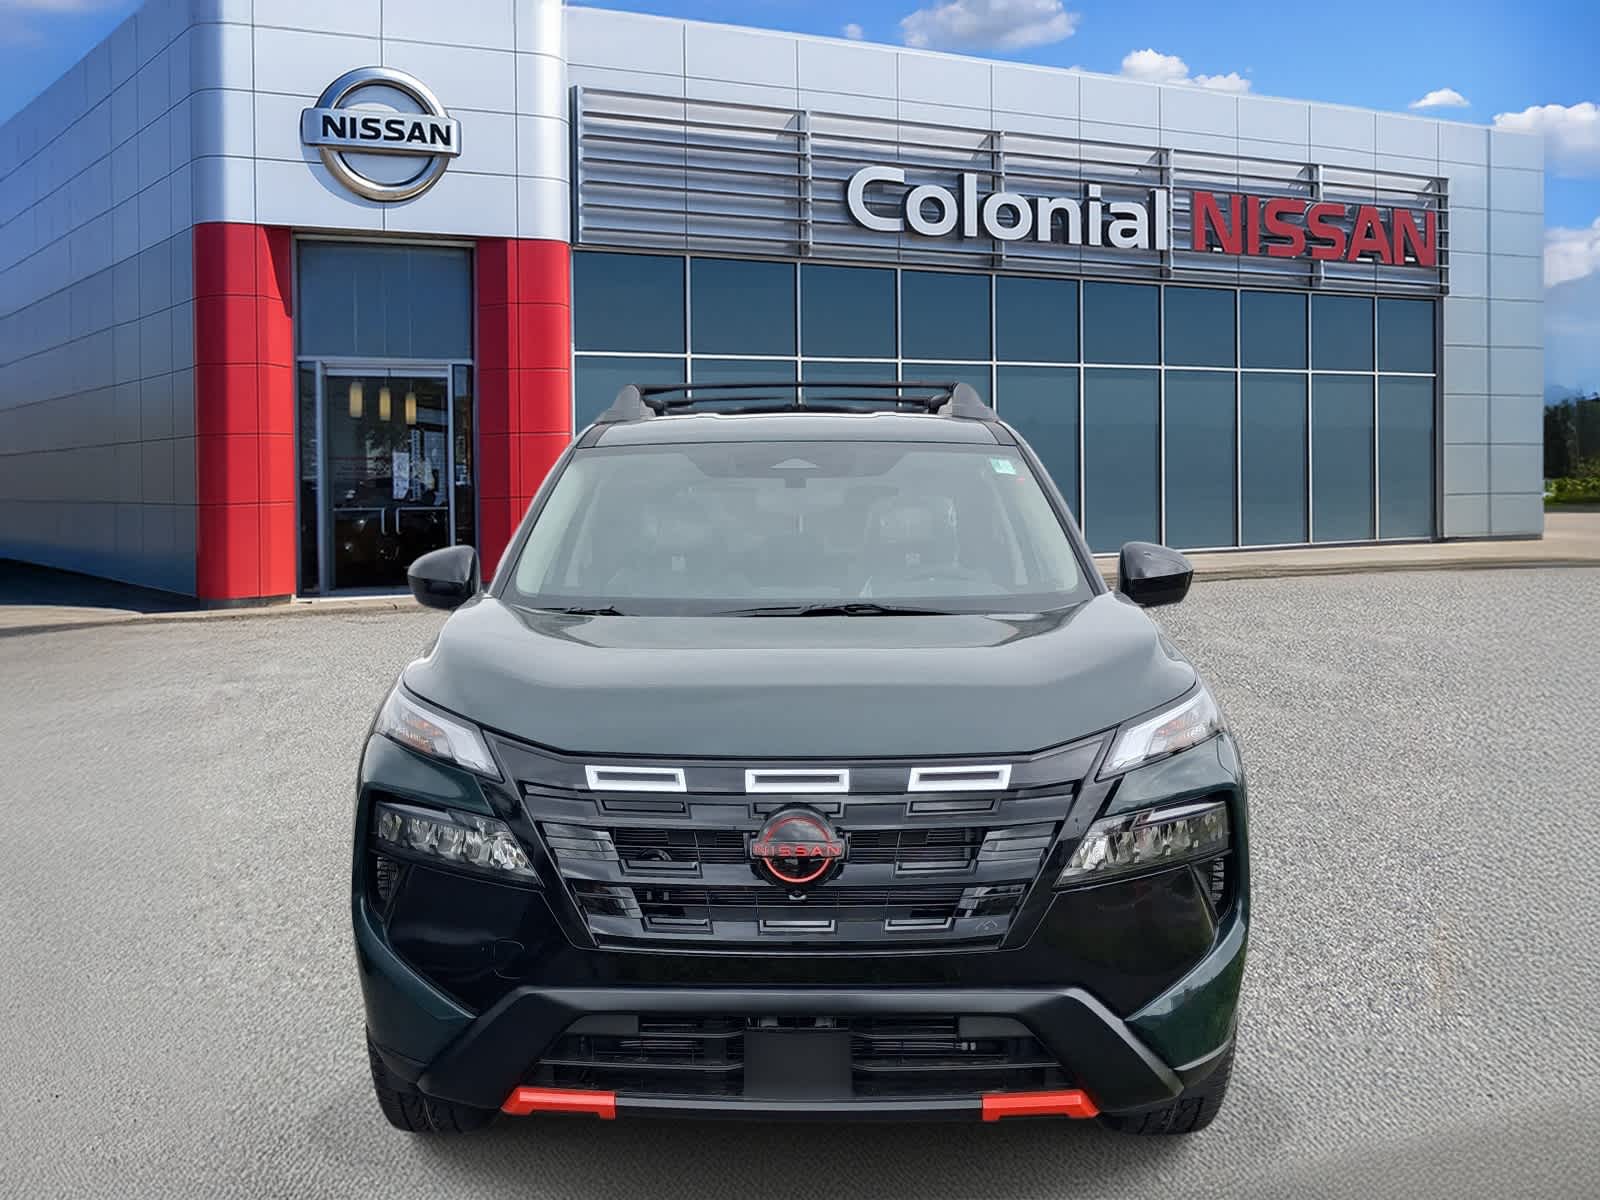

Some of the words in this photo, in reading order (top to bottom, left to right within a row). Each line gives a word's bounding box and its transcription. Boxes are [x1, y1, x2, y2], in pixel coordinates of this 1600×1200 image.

[322, 115, 451, 146] NISSAN
[847, 165, 1167, 250] Colonial
[1192, 191, 1436, 267] NISSAN
[752, 843, 842, 857] NISSAN
